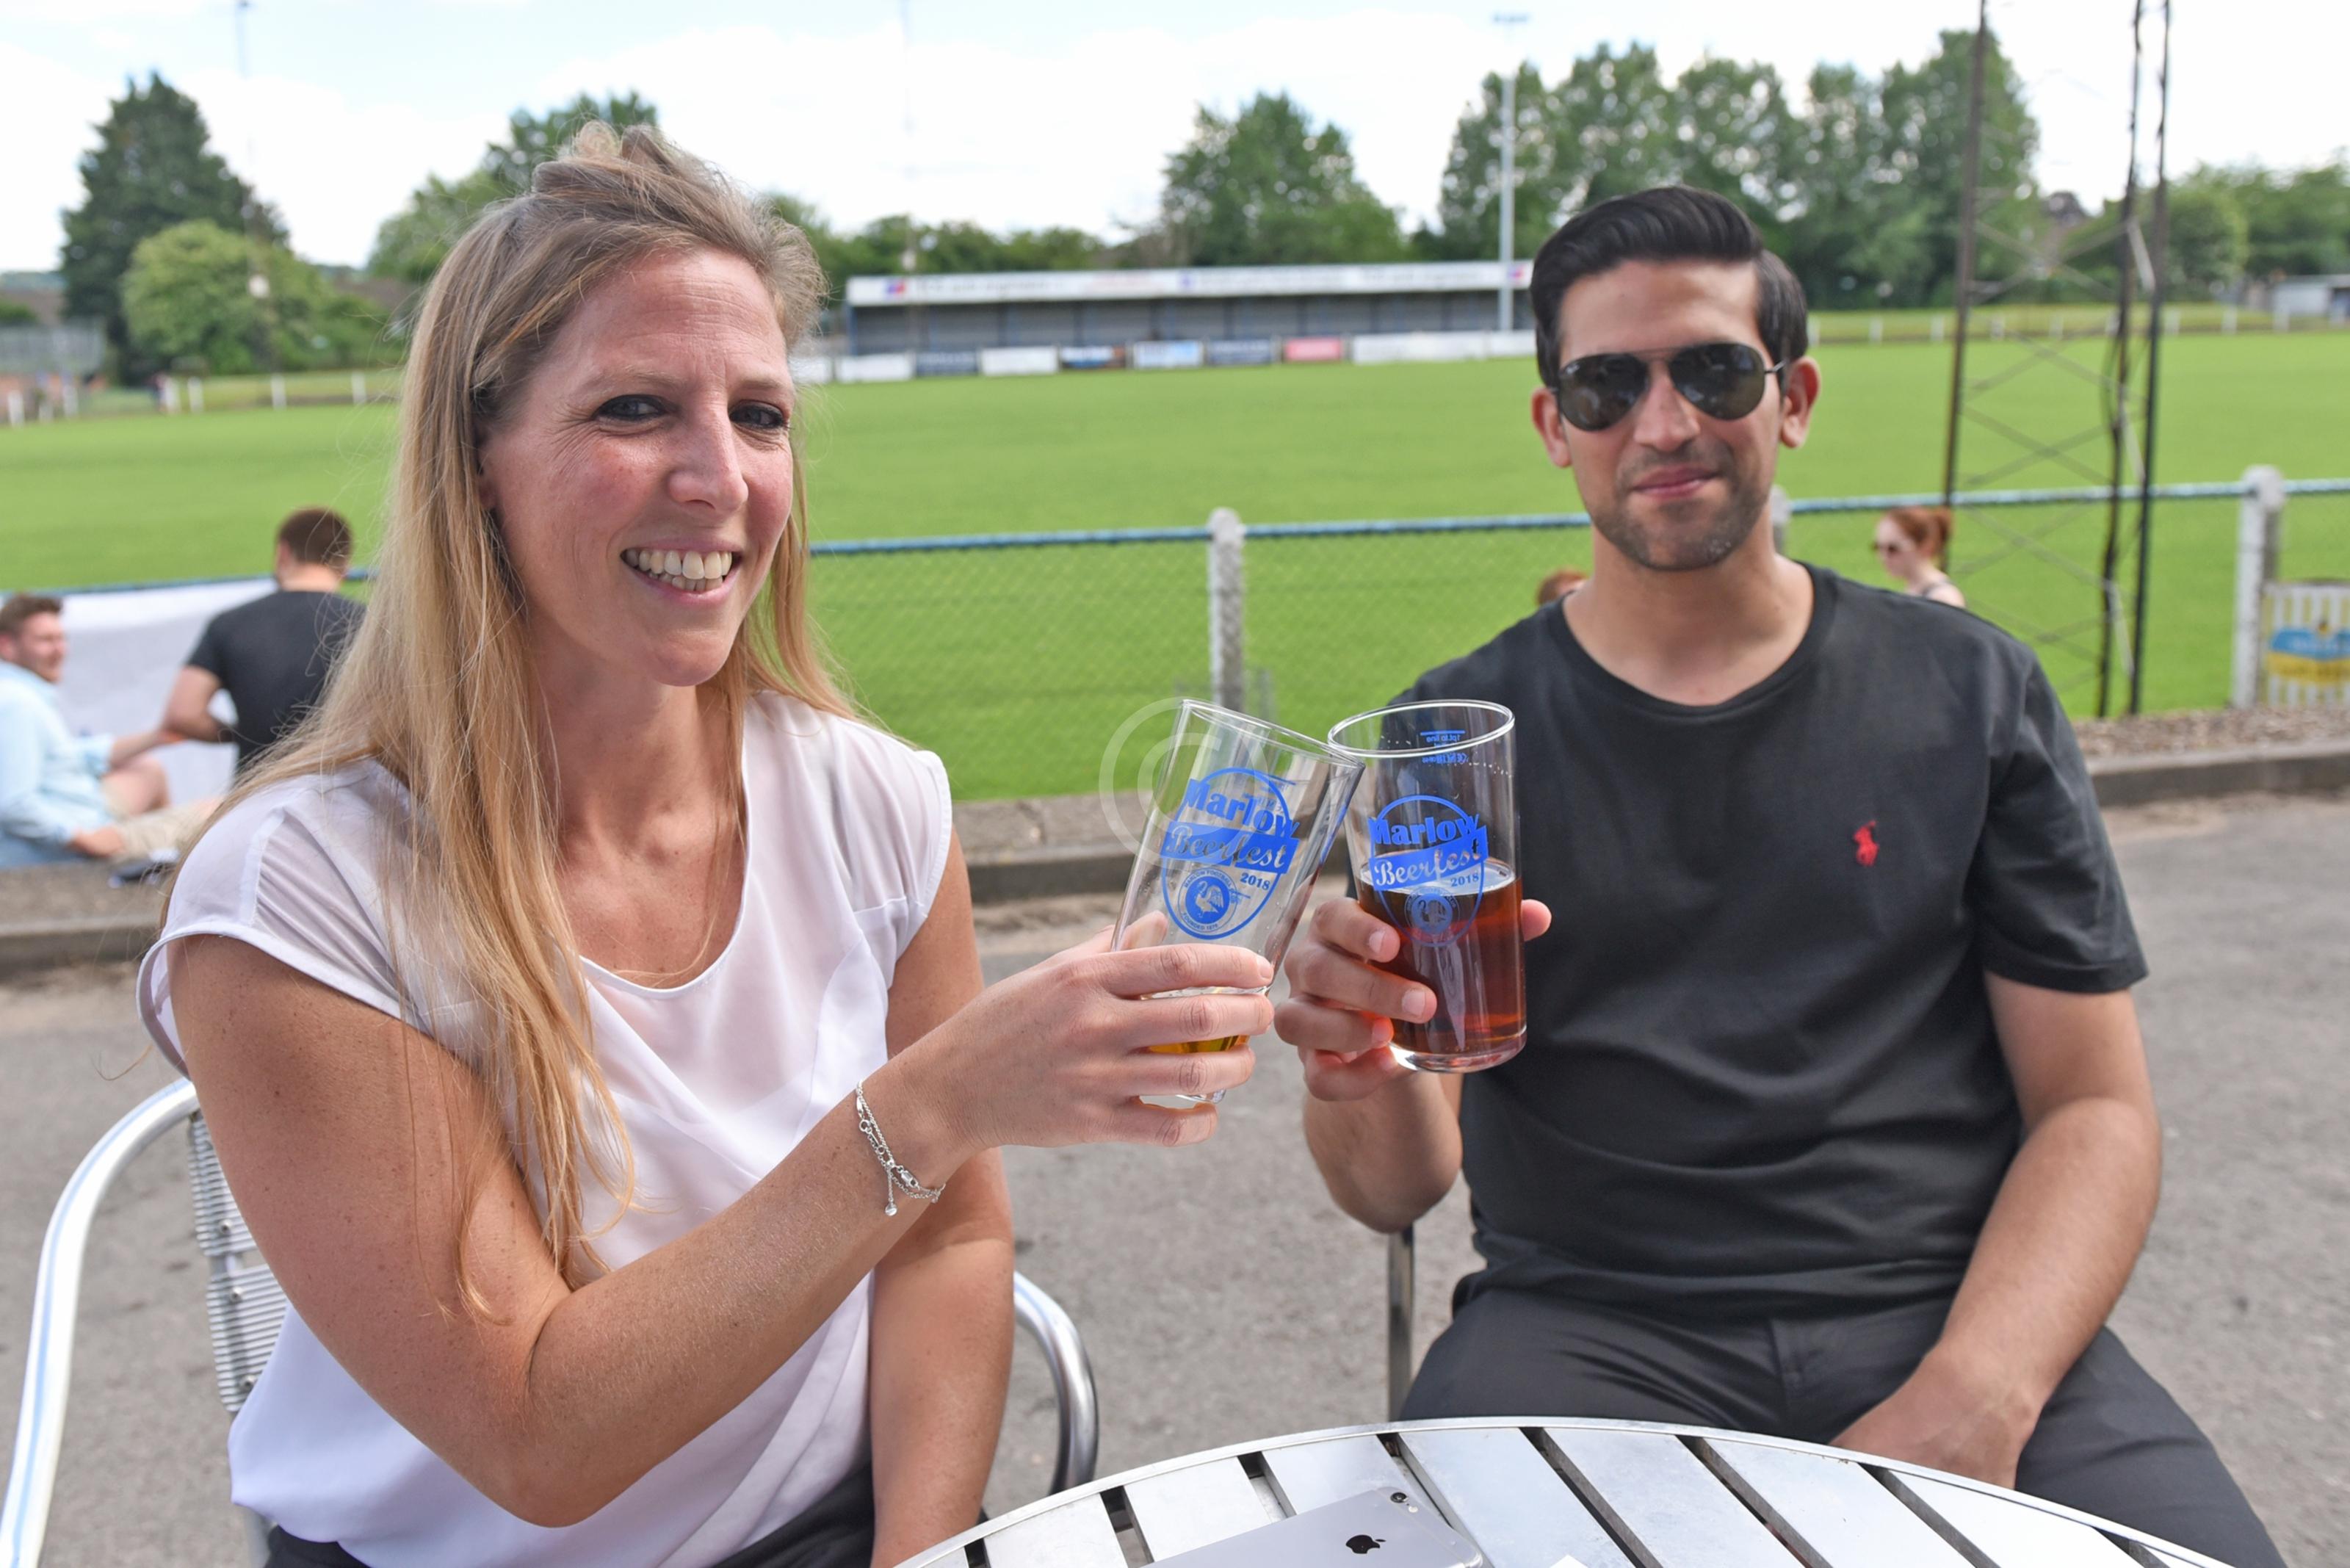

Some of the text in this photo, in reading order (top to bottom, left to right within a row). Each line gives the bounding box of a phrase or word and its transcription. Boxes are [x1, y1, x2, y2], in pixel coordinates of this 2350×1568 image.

[1181, 778, 1301, 837] Marlow
[1165, 825, 1287, 869] Beerfest
[1367, 814, 1480, 845] Marlow
[1374, 837, 1480, 886] Beerfest
[1450, 872, 1480, 886] 2018
[1240, 872, 1270, 890] 2018
